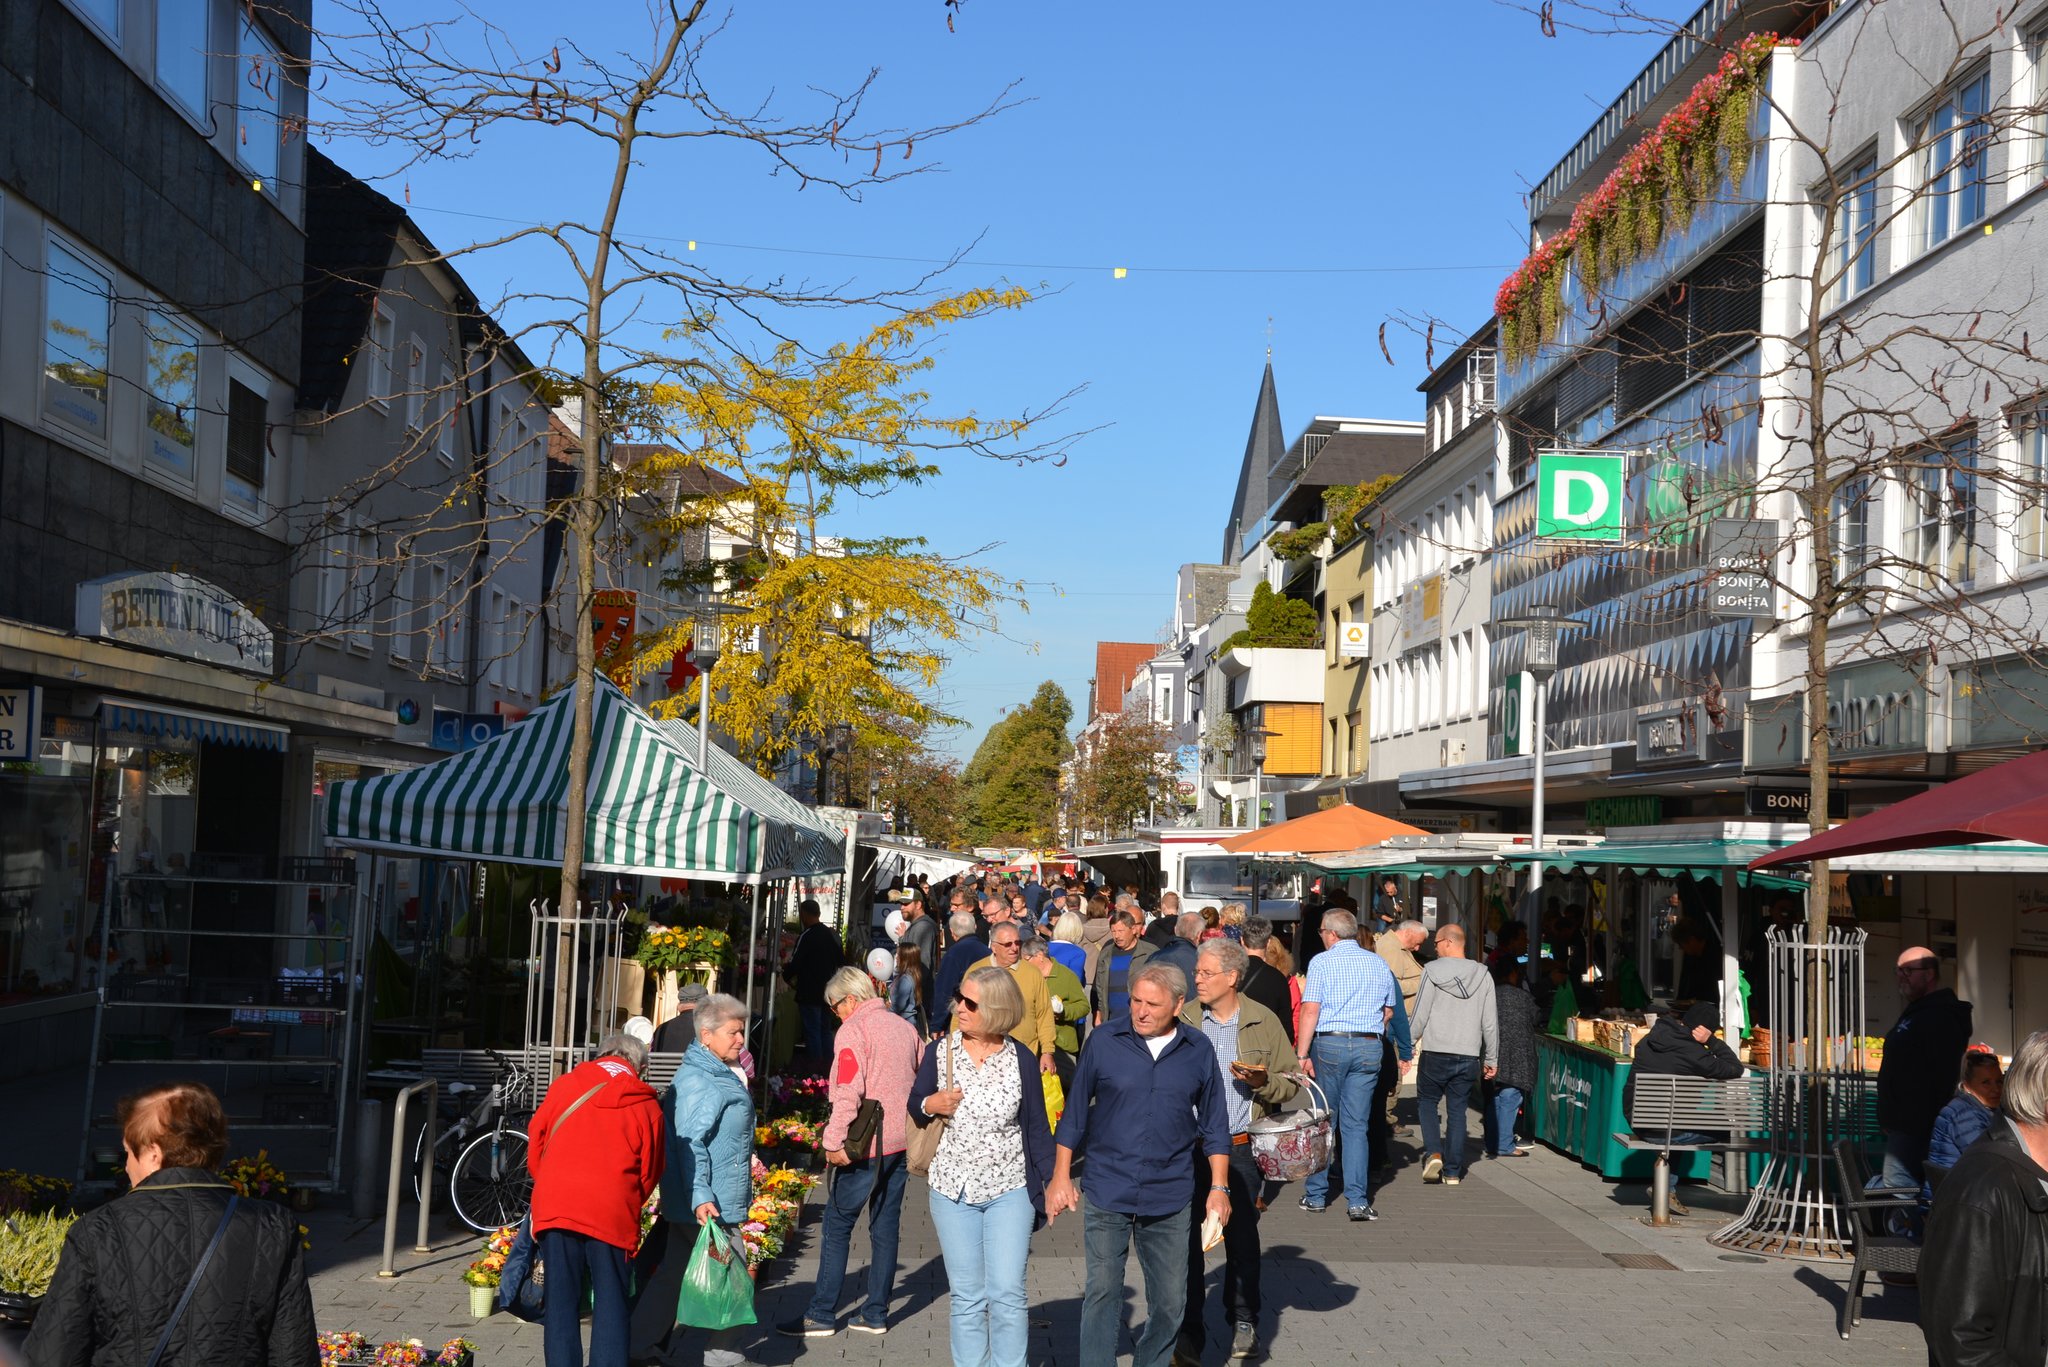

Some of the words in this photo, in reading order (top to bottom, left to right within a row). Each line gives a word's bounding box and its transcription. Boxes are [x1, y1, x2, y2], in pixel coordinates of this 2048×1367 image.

[1553, 469, 1609, 525] D
[112, 587, 193, 632] BETTEN
[195, 594, 273, 668] MÜLLER
[1507, 688, 1520, 741] D
[1585, 797, 1658, 827] DEICHMANN
